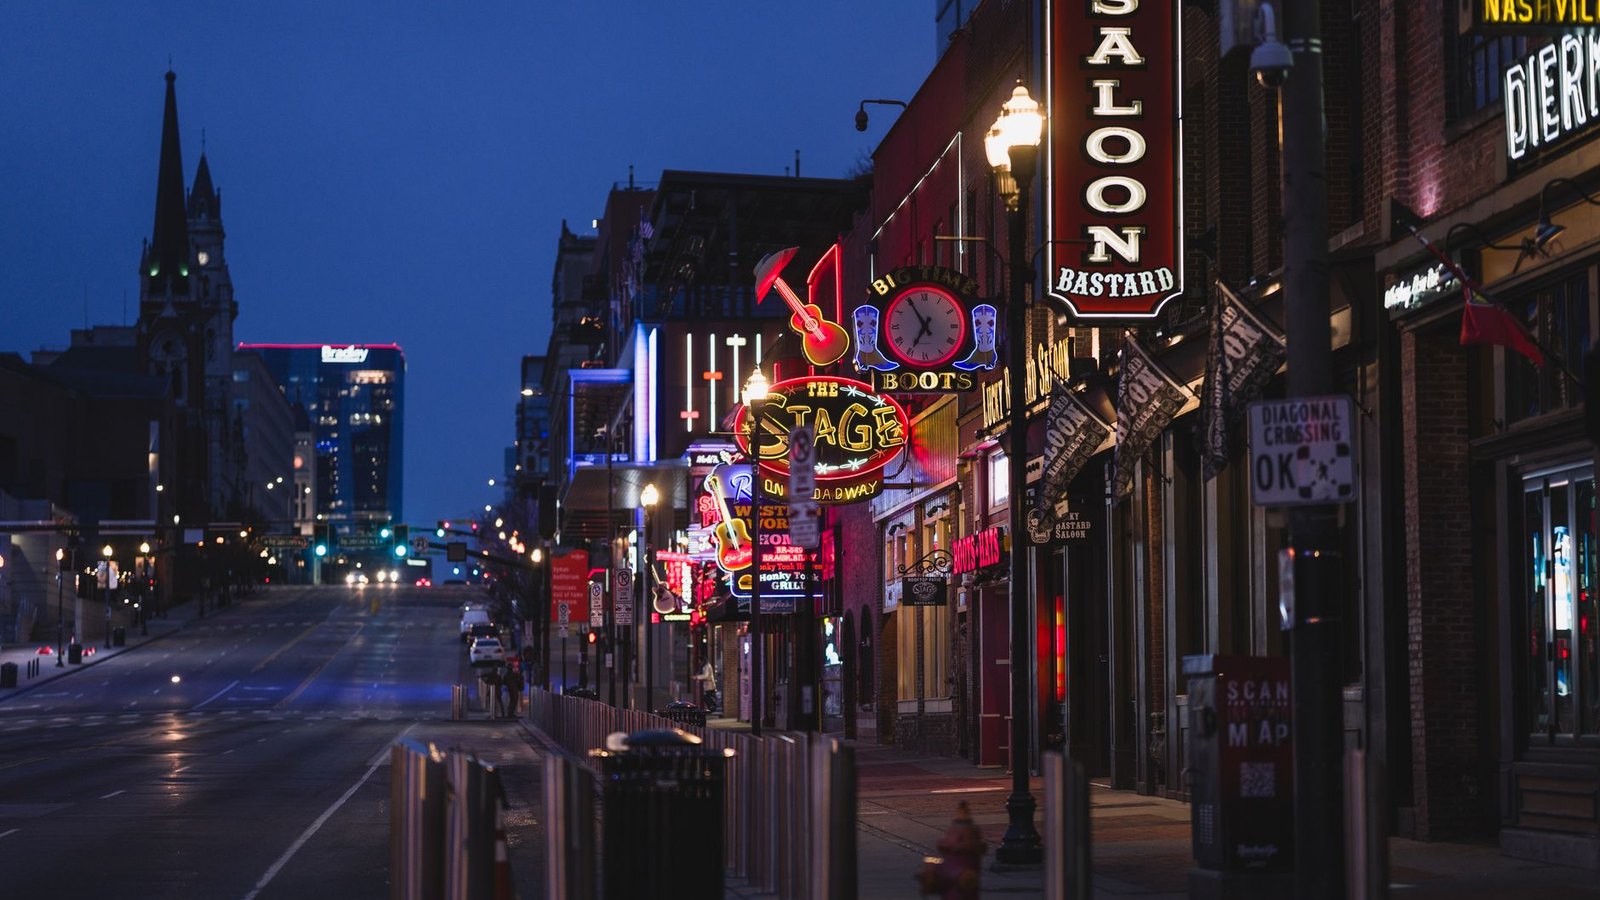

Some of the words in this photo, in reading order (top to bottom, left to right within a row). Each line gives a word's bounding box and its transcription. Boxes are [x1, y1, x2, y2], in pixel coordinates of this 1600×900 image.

[1484, 0, 1600, 22] NASHVIL
[872, 269, 911, 297] BIG
[1056, 267, 1175, 298] BASTARD
[807, 382, 839, 398] THE
[882, 371, 973, 391] BOOTS
[981, 380, 1004, 429] LUCKY
[1037, 336, 1070, 397] SALOON
[1262, 402, 1341, 424] DIAGONAL
[747, 392, 905, 460] STAGE
[1264, 422, 1341, 446] CROSSING
[1256, 453, 1296, 491] OK
[764, 478, 784, 497] ON
[1055, 530, 1086, 539] SALOON
[952, 534, 976, 575] BOOTS
[978, 526, 1000, 568] HATS
[759, 563, 776, 573] onky
[759, 572, 791, 583] Honky
[793, 571, 820, 582] Tok
[771, 581, 806, 591] GRILL
[1227, 680, 1289, 701] SCAN
[1229, 720, 1288, 747] MAP
